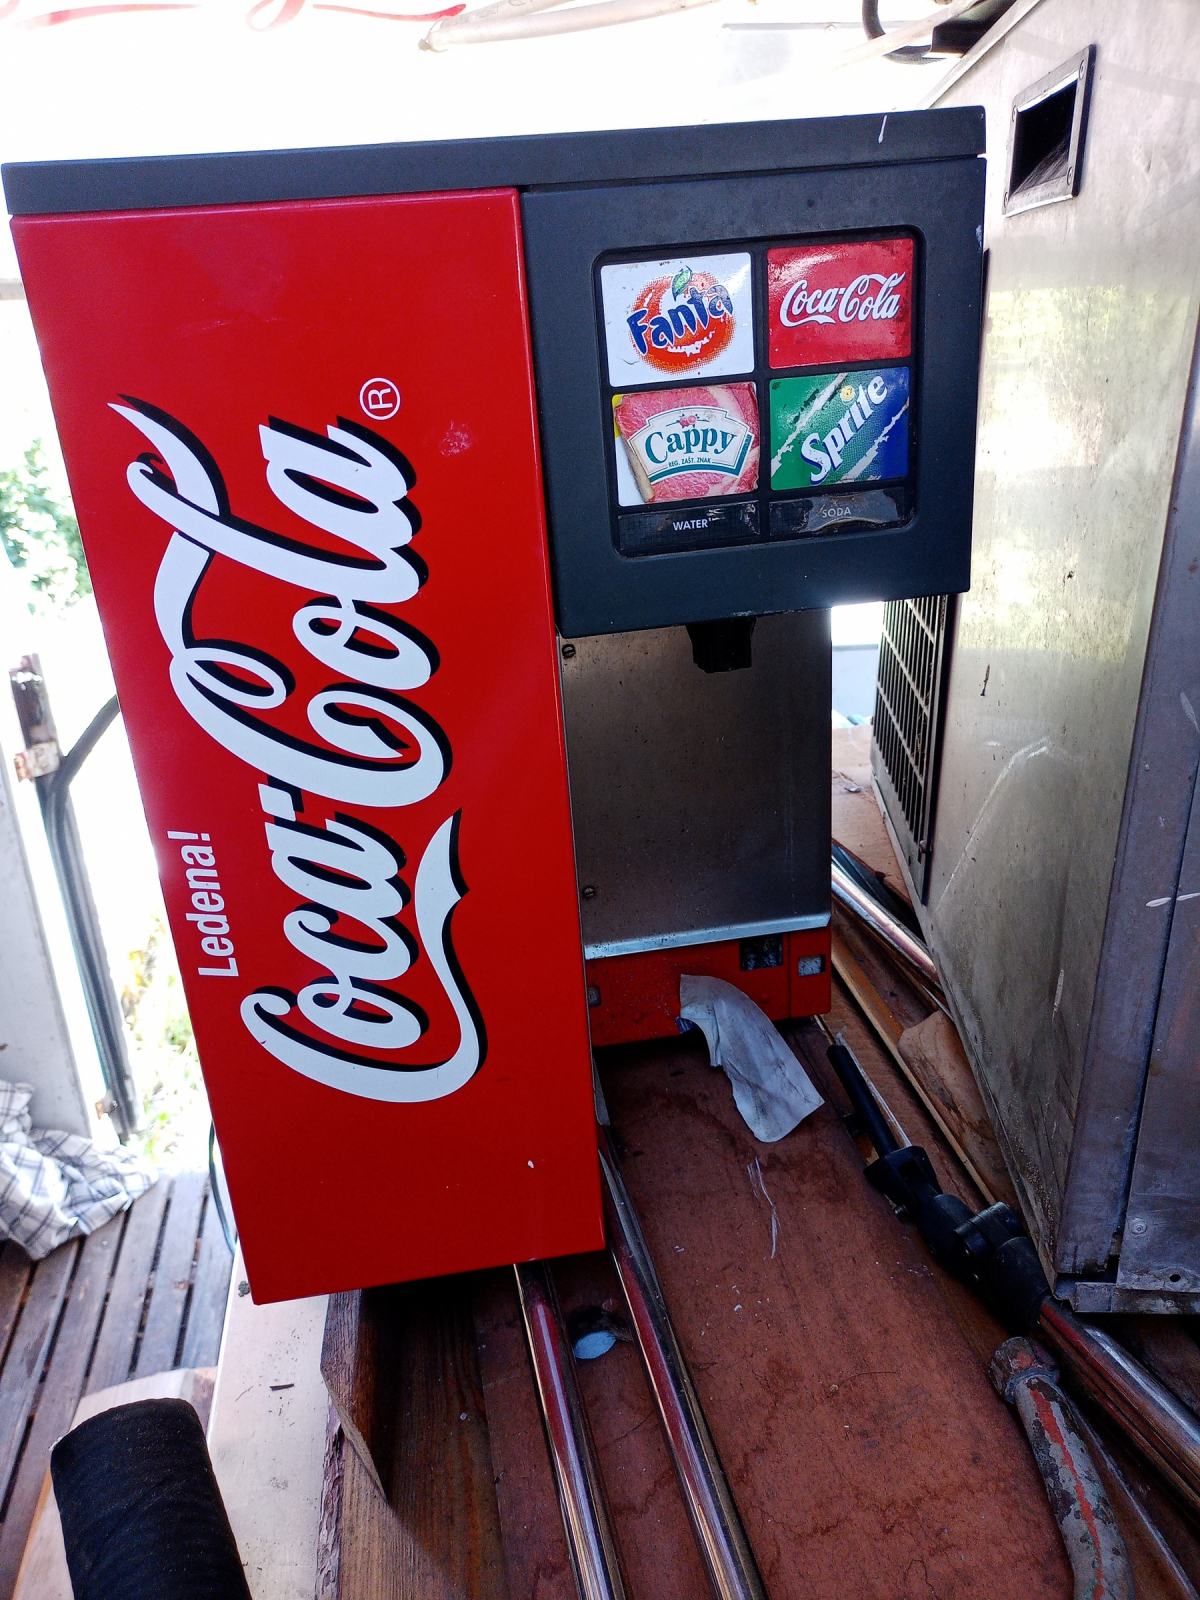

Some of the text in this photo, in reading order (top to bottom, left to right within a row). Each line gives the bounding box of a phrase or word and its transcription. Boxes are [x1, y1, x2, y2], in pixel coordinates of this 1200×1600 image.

[626, 284, 734, 356] Fanta
[779, 271, 906, 327] Coca-Cola
[645, 426, 738, 464] Cappy
[800, 375, 888, 486] Sprite
[672, 518, 709, 532] WATER
[821, 506, 851, 519] SODA
[107, 393, 482, 1103] Coca-Cola
[167, 829, 239, 977] Ledena!
